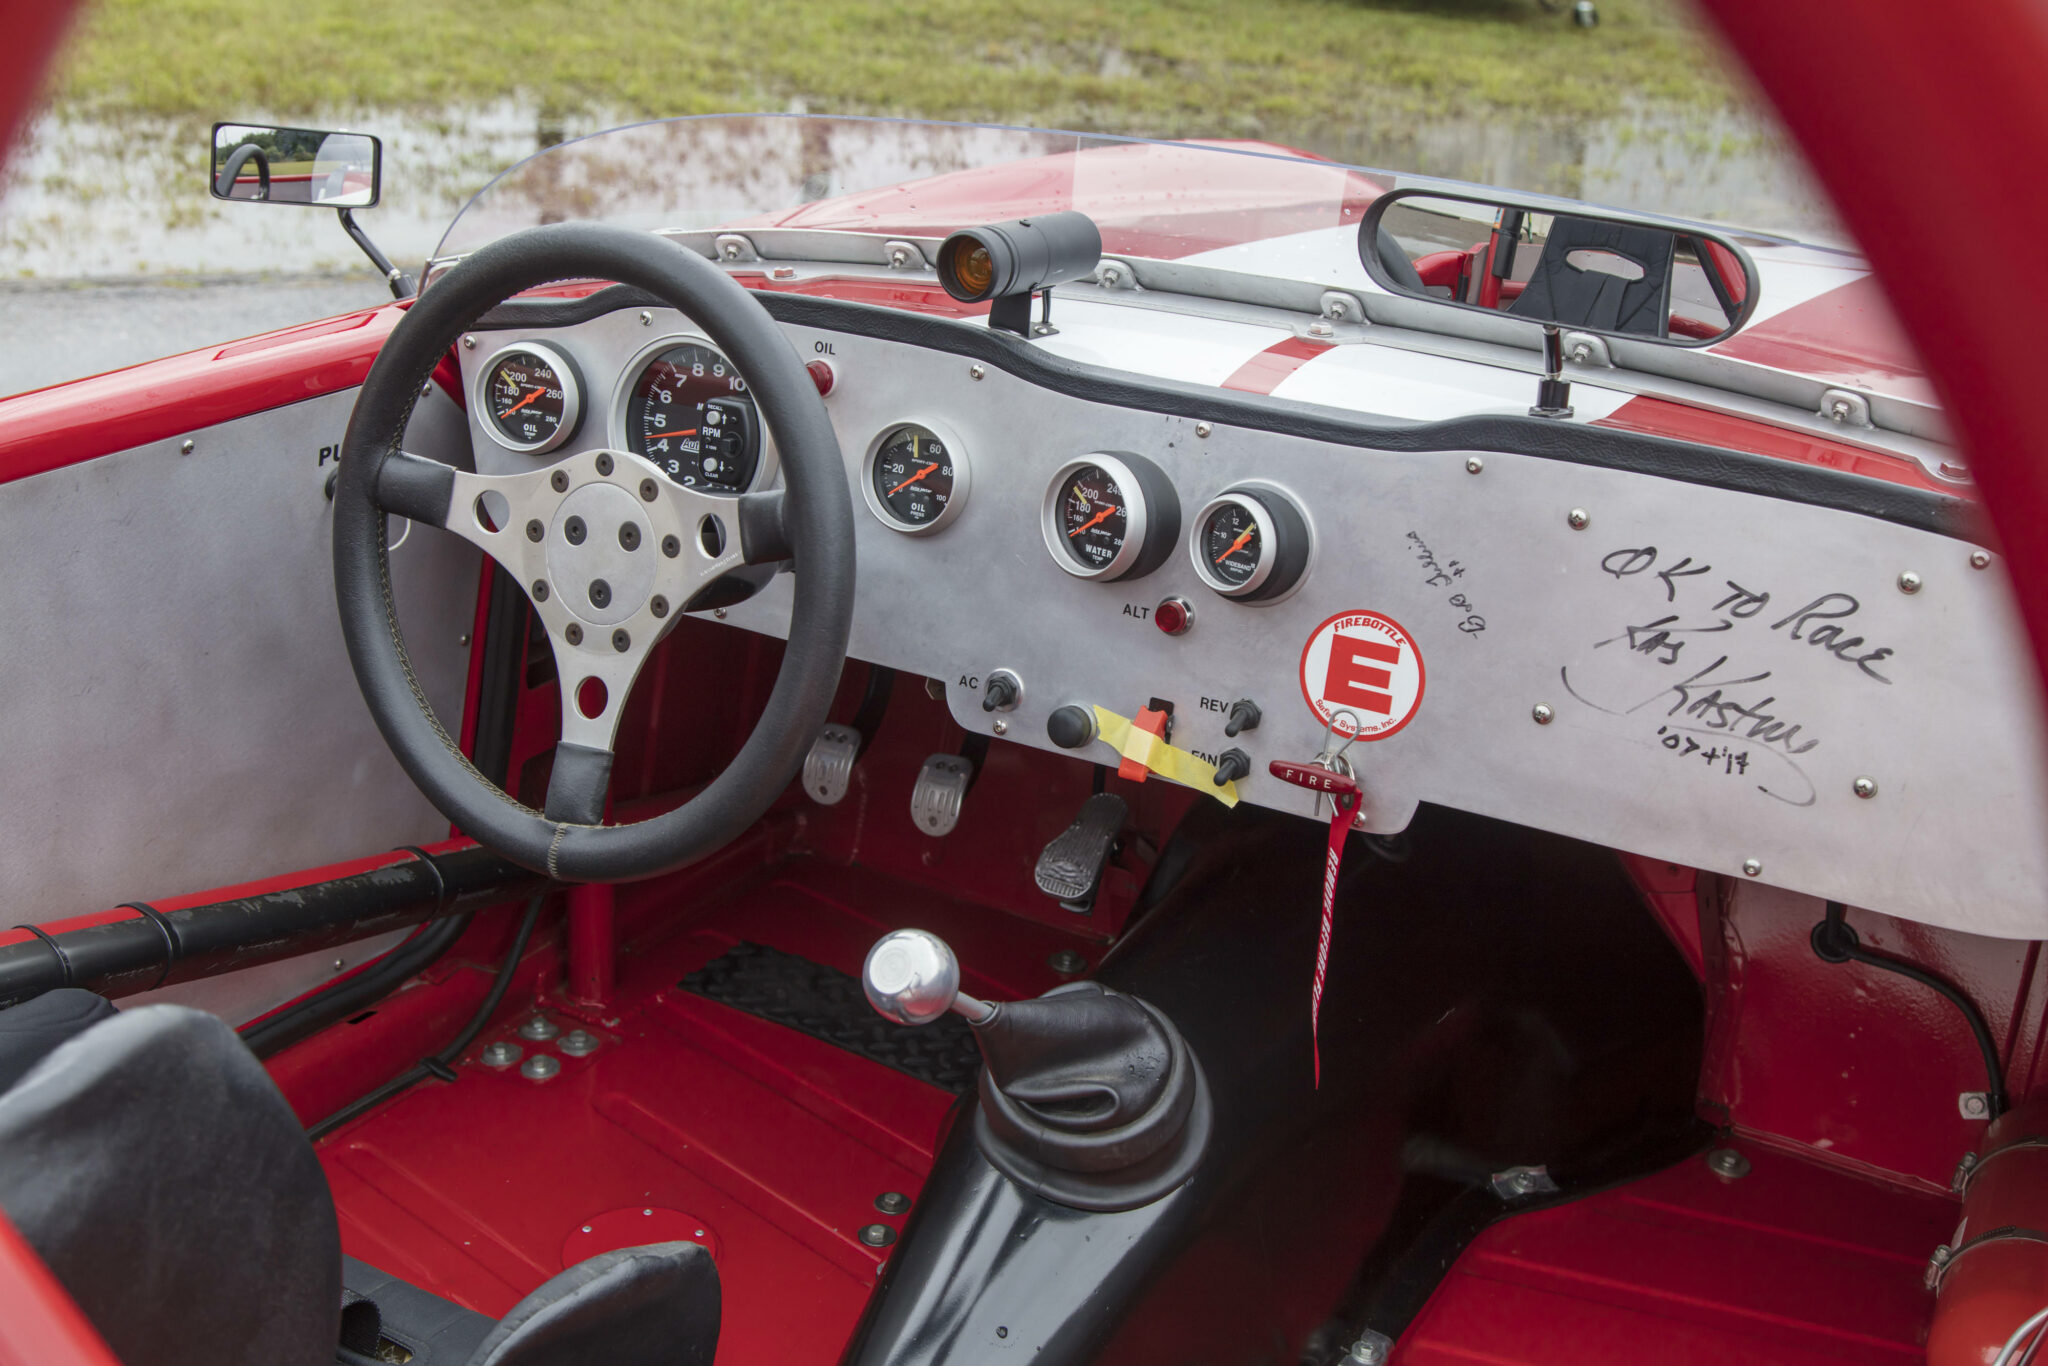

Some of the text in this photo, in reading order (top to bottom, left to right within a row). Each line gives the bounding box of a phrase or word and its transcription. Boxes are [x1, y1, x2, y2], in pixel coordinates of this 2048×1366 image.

[815, 341, 836, 355] OIL
[509, 371, 527, 382] 200
[534, 368, 551, 379] 240
[692, 363, 704, 377] 8
[713, 364, 725, 377] 9
[674, 374, 687, 387] 7
[729, 376, 746, 392] 10
[503, 385, 519, 396] 180
[546, 388, 563, 400] 260
[660, 390, 672, 403] 6
[654, 414, 666, 427] 5
[523, 423, 537, 433] OIL
[702, 426, 721, 438] RPM
[657, 438, 669, 452] 4
[680, 437, 700, 454] Aut
[929, 443, 942, 454] 60
[668, 459, 680, 473] 3
[892, 463, 905, 474] 20
[942, 465, 954, 477] 80
[683, 475, 696, 486] 2
[936, 494, 947, 502] 100
[1082, 486, 1099, 500] 200
[911, 502, 926, 512] OIL
[1075, 500, 1092, 513] 180
[1085, 544, 1112, 559] WATER
[1225, 559, 1252, 571] WIDEBAND
[1122, 603, 1150, 620] ALT
[1333, 616, 1407, 647] FIREBOTTLE
[1322, 633, 1401, 716] E
[959, 675, 979, 689] AC
[1200, 696, 1229, 713] REV
[1286, 768, 1332, 789] FIRE
[1323, 847, 1339, 917] REMOVE
[1317, 913, 1331, 981] BEFORE
